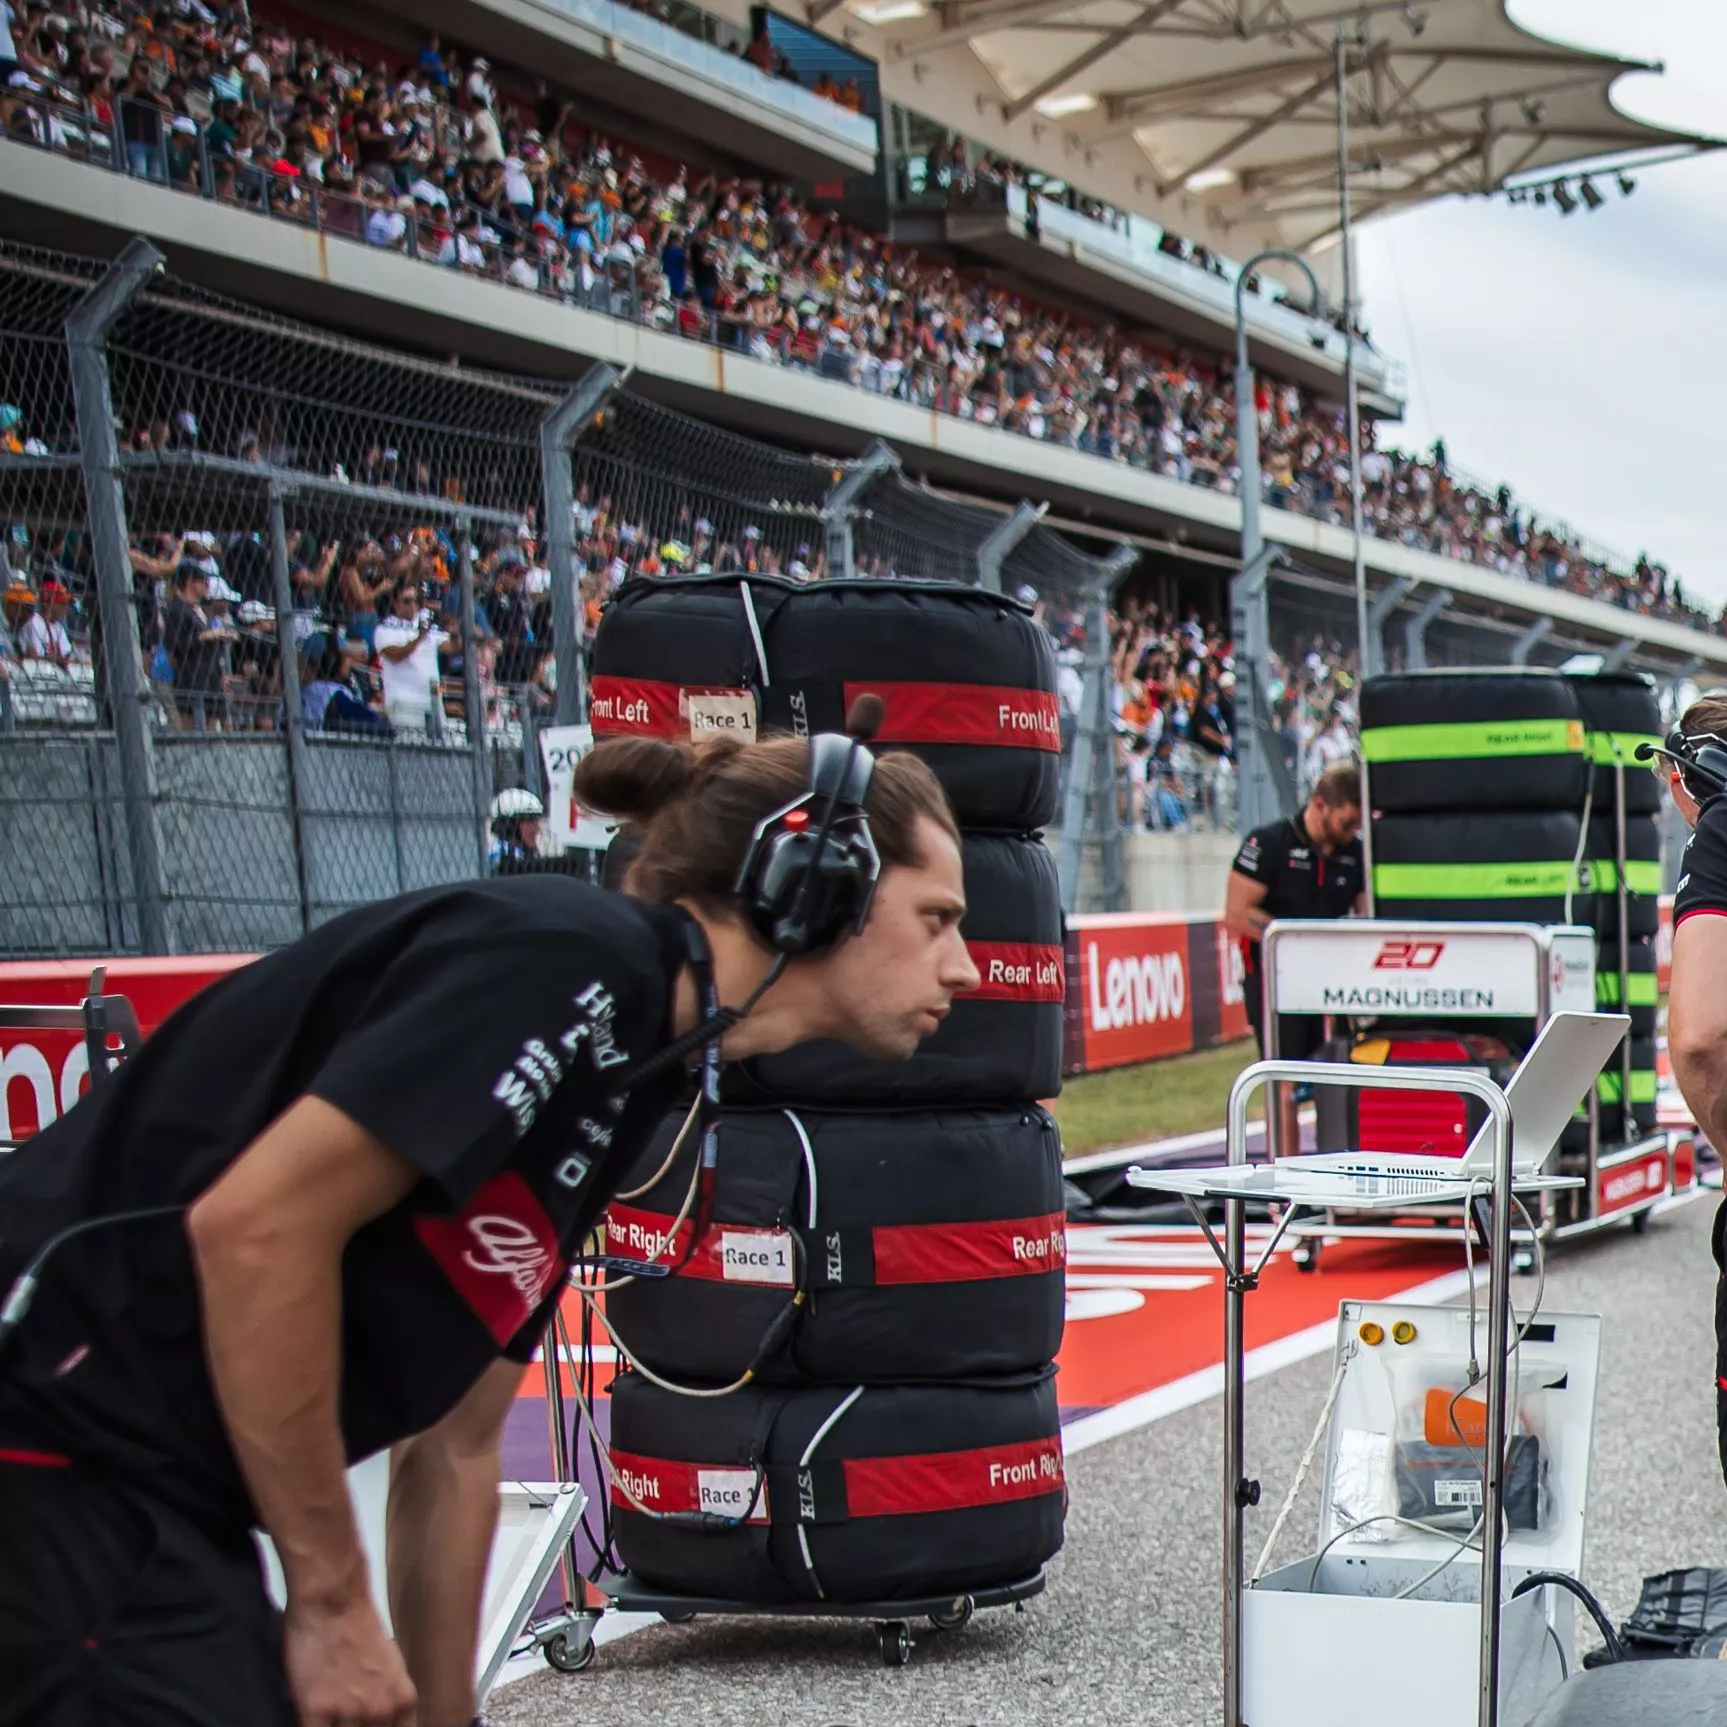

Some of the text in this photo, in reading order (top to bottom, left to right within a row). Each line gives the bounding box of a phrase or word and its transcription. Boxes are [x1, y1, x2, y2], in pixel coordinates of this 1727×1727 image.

[617, 699, 650, 725] Left
[694, 711, 752, 730] Race 1
[999, 706, 1043, 732] Front
[1372, 940, 1447, 970] 20
[989, 959, 1058, 985] Rear Left
[1088, 940, 1186, 1032] Lenovo
[1323, 987, 1495, 1009] MAGNUSSEN
[628, 1221, 676, 1258] Right
[1013, 1236, 1049, 1260] Rear
[725, 1247, 787, 1267] Race 1
[827, 1230, 843, 1284] KLS
[989, 1460, 1037, 1488] Front
[700, 1486, 741, 1505] Race
[800, 1469, 815, 1521] KLS
